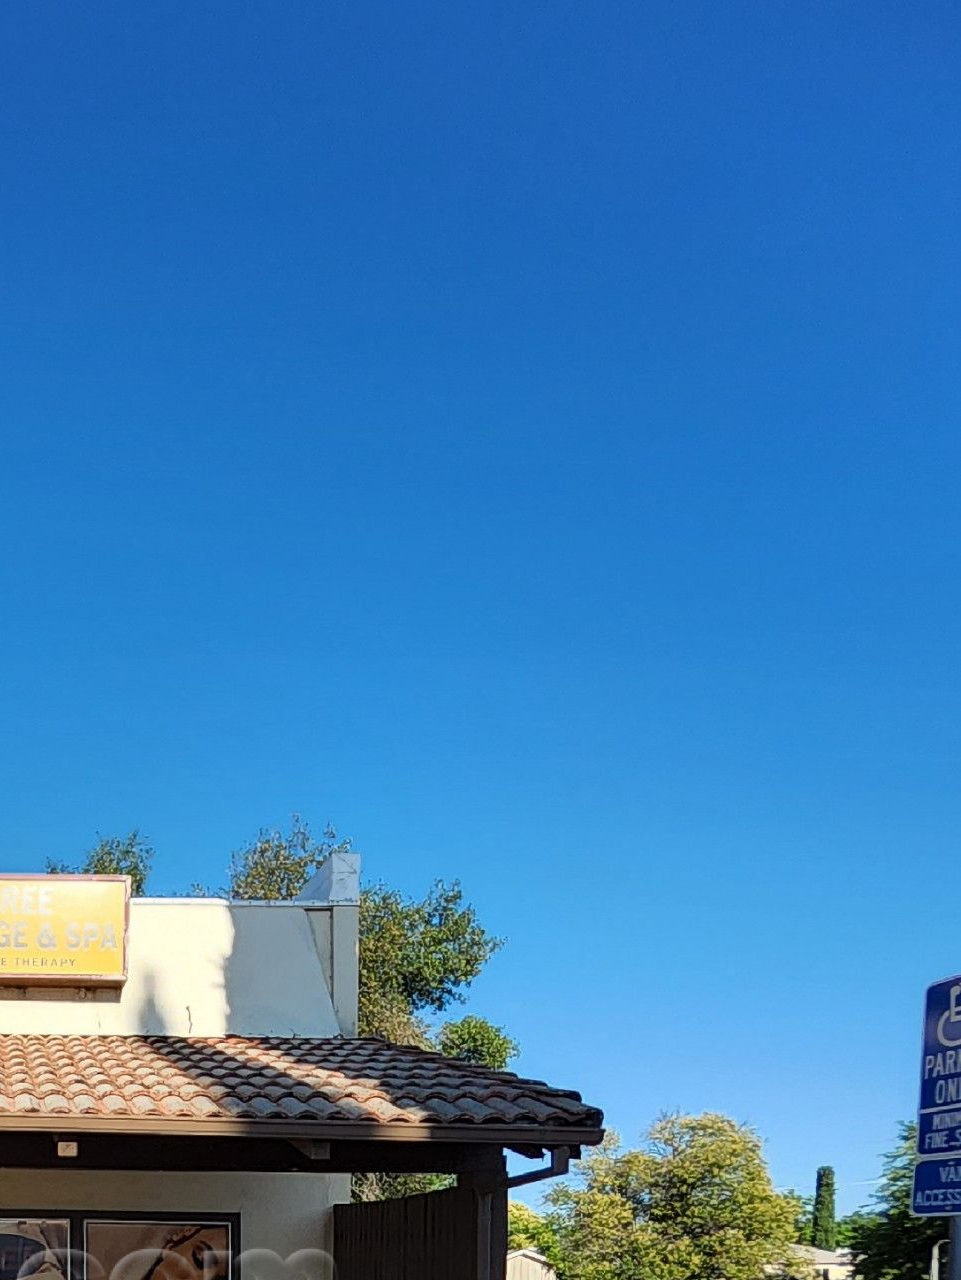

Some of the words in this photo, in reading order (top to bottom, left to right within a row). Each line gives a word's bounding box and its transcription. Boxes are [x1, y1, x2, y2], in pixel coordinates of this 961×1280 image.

[37, 922, 57, 949] &
[64, 921, 118, 950] SPA
[14, 957, 76, 967] THERAPY
[925, 1050, 961, 1080] PAR
